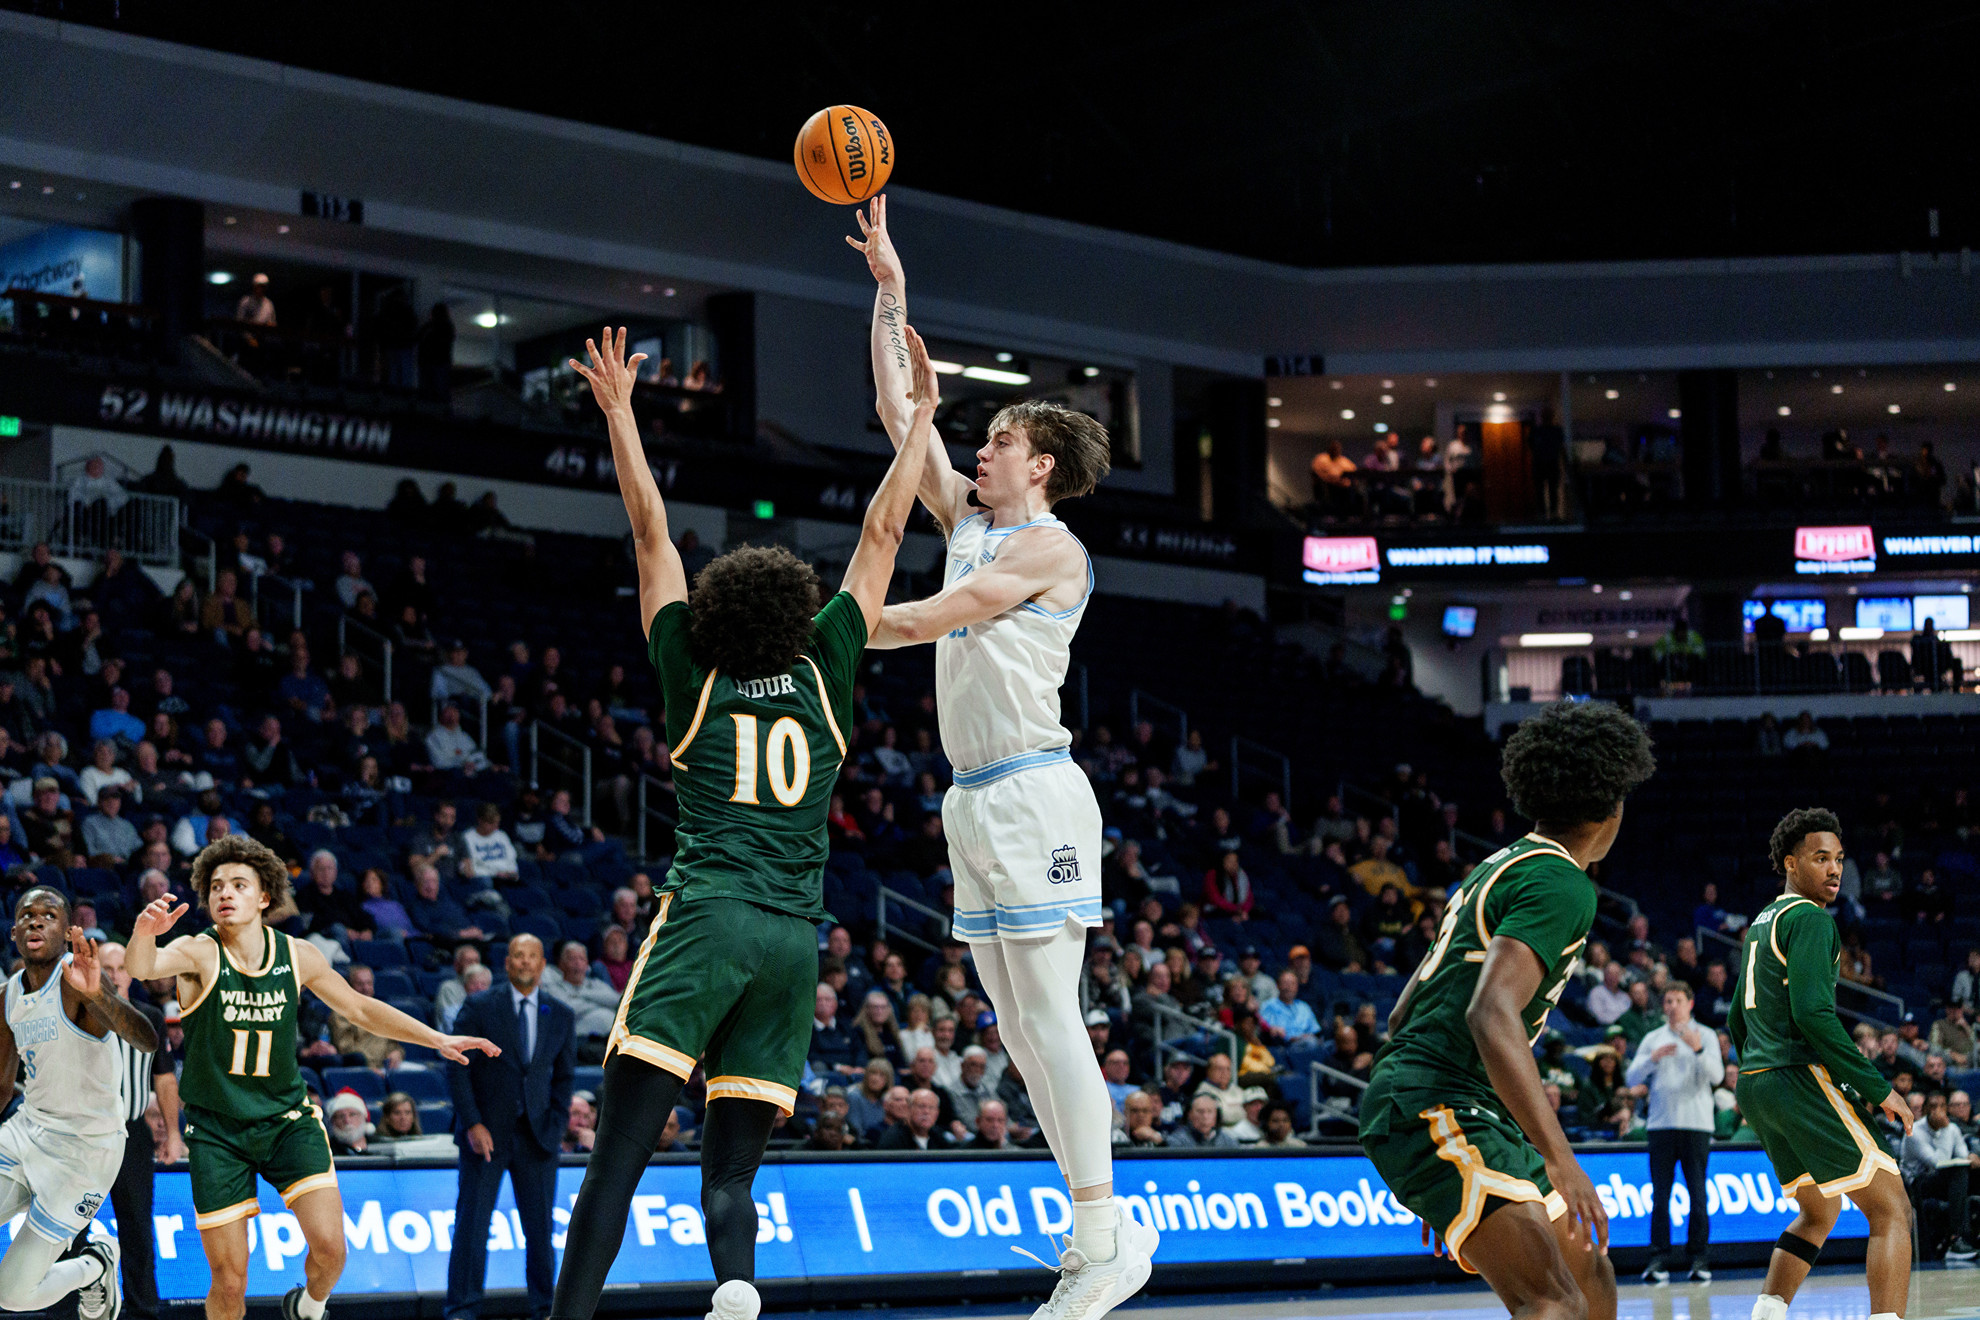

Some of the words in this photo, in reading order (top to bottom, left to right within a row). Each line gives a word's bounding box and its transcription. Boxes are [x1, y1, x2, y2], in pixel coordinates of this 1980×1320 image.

[841, 115, 867, 181] Wilson
[870, 120, 889, 165] NCAA
[879, 293, 909, 368] Invictus
[100, 385, 149, 424] 52
[159, 391, 392, 456] WASHINGTON
[545, 446, 586, 480] 45
[1386, 547, 1473, 566] WHATEVER
[1883, 536, 1972, 555] WHATEVER
[736, 674, 796, 698] NDUR
[729, 713, 811, 807] 10
[1047, 862, 1082, 884] ODU
[220, 988, 288, 1007] WILLIAM
[1745, 940, 1759, 1010] 1
[228, 1029, 273, 1077] 11
[632, 1192, 794, 1246] Fas!
[927, 1185, 1022, 1237] Old
[1030, 1179, 1269, 1236] Dminion
